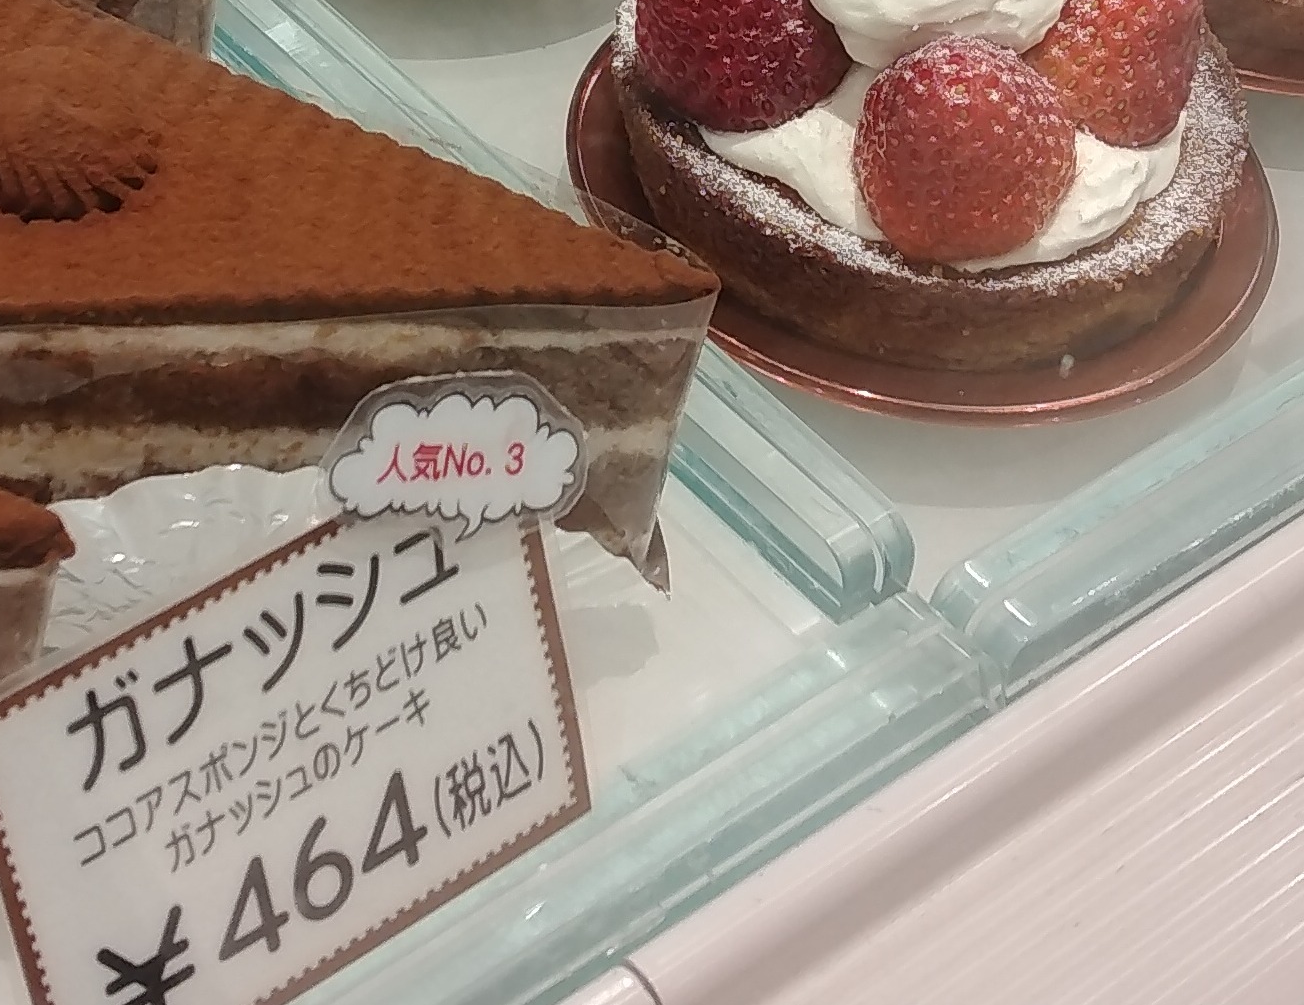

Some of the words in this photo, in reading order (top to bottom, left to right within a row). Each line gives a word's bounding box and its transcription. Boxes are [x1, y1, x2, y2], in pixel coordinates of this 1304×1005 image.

[67, 527, 460, 791] ガナッシュ
[72, 602, 488, 866] ココアスポンジとくちどけ良い
[166, 688, 431, 873] ガナッシュのケーキ
